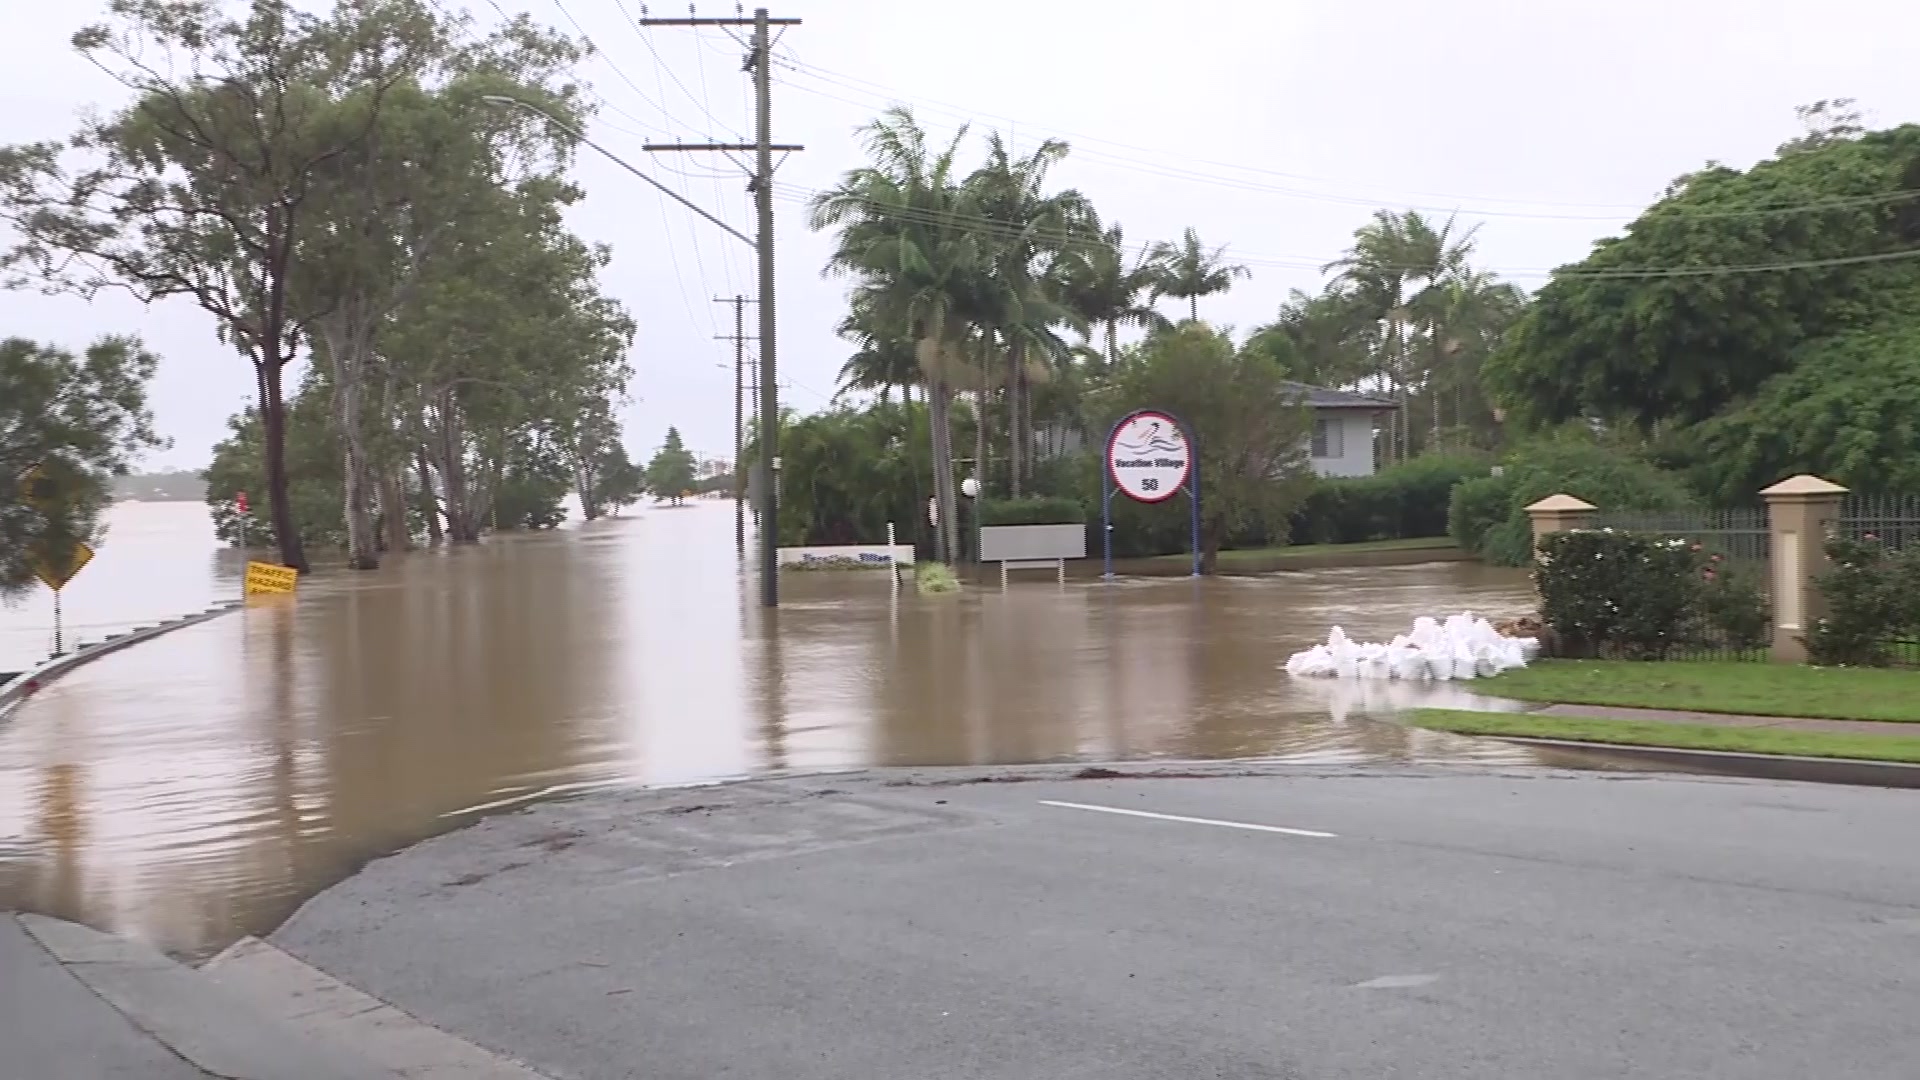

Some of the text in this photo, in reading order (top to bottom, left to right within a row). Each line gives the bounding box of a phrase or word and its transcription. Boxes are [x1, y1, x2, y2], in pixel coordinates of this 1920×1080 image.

[1114, 458, 1185, 469] Vacation Village
[1141, 478, 1159, 491] 50
[250, 565, 294, 580] TRAFFIC
[247, 577, 292, 590] HAZARD
